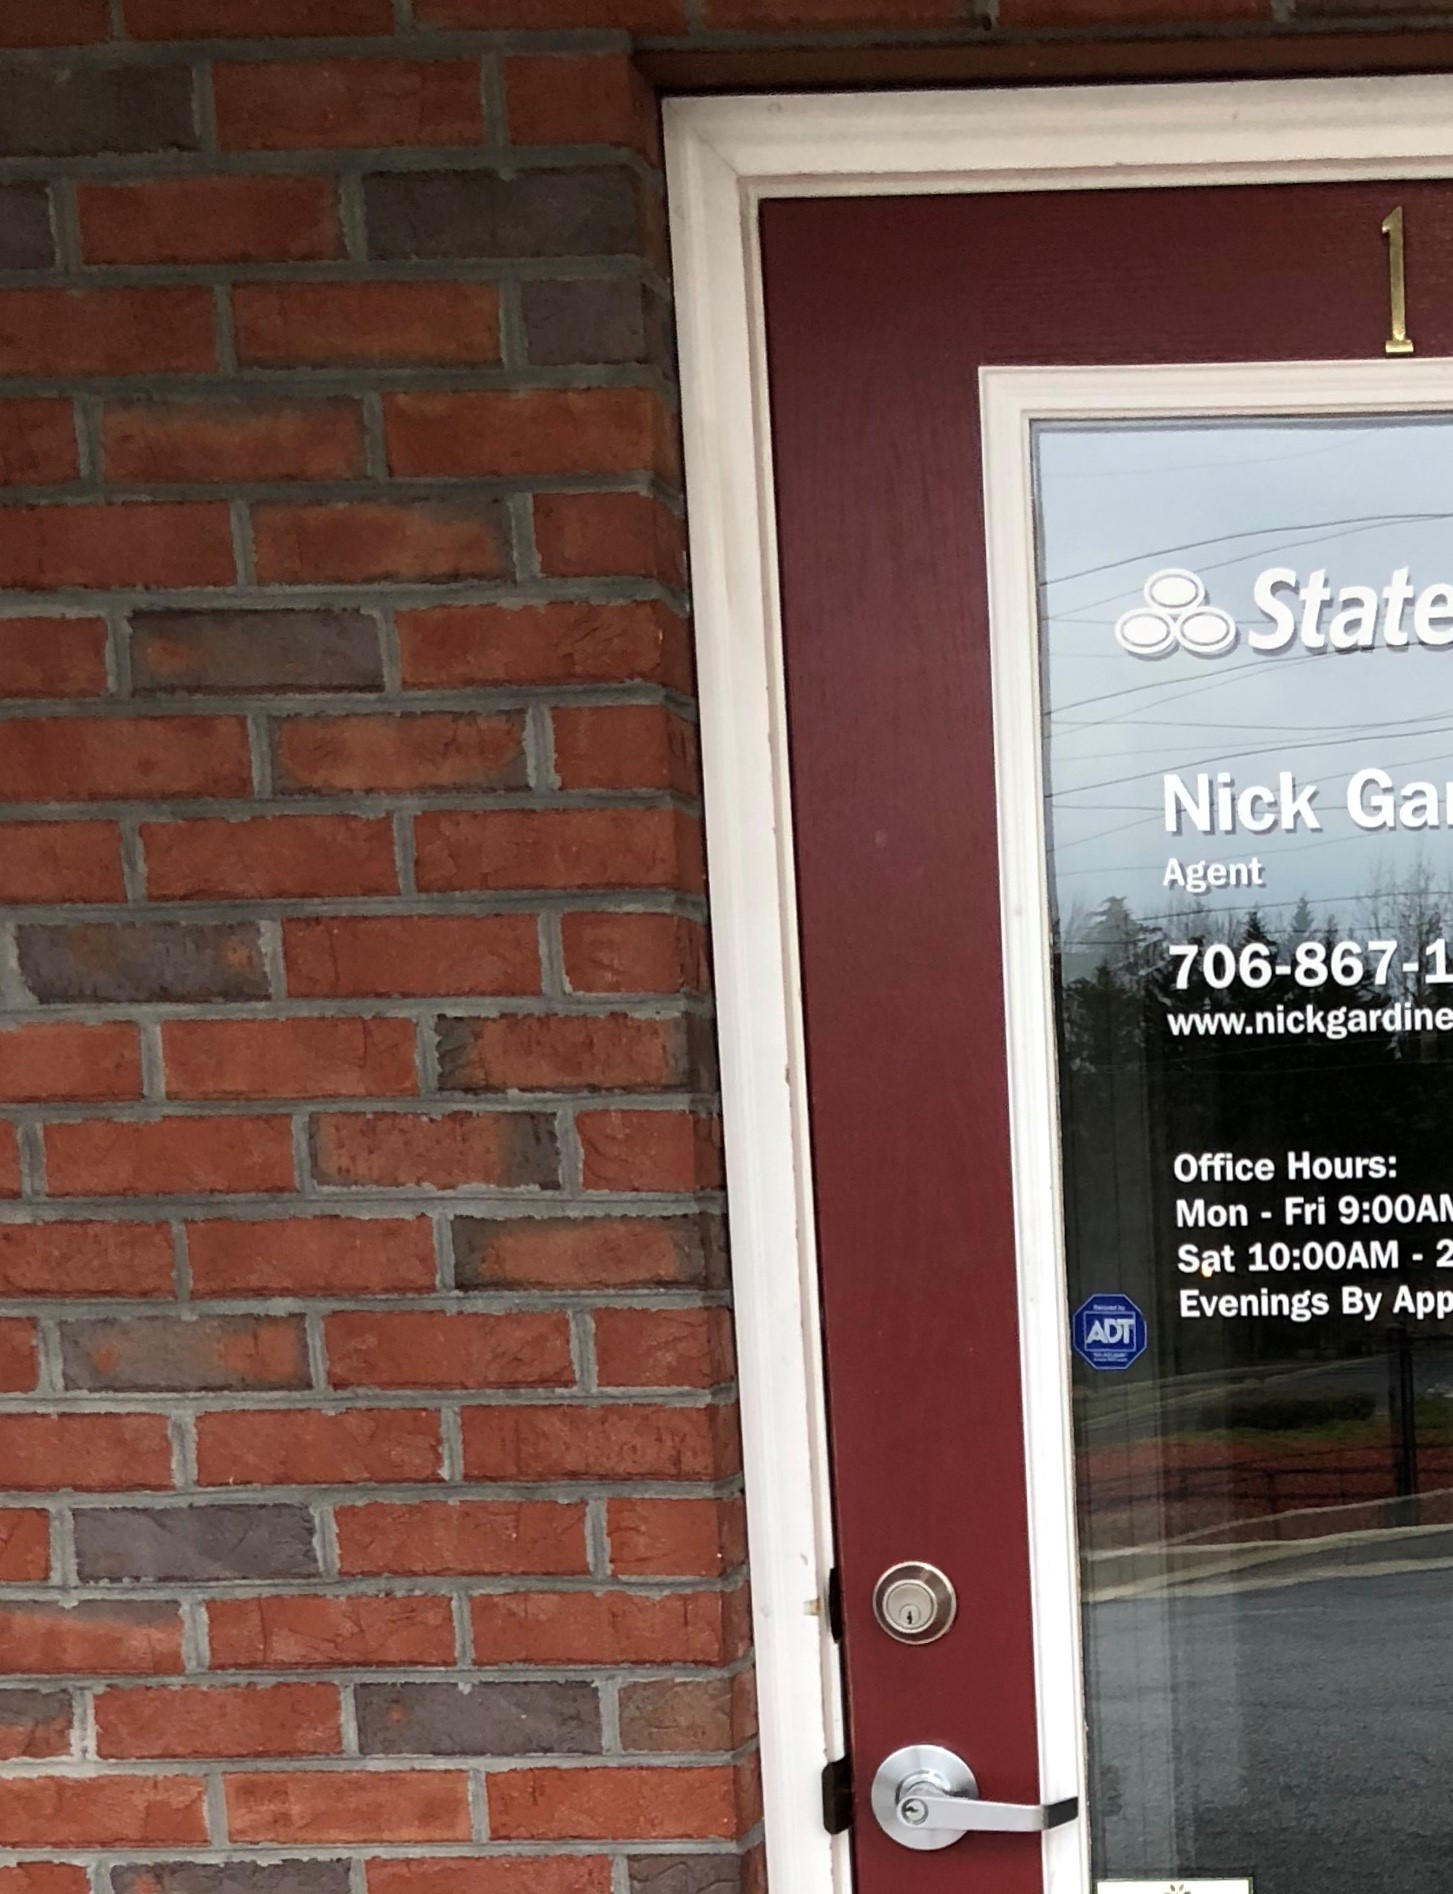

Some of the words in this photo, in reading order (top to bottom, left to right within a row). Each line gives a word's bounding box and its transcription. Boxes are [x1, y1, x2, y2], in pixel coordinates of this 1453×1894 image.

[1381, 205, 1414, 354] 1
[1163, 771, 1322, 832] Nick
[1162, 857, 1264, 893] Agent
[1174, 1152, 1275, 1183] Office
[1287, 1151, 1398, 1180] Hours:
[1176, 1198, 1249, 1228] Mon
[1285, 1196, 1326, 1226] Fri
[1177, 1243, 1236, 1273] Sat
[1248, 1240, 1400, 1271] 10:00AM
[1179, 1287, 1330, 1322] Evenings
[1342, 1286, 1383, 1321] By
[1086, 1317, 1135, 1345] ADT
